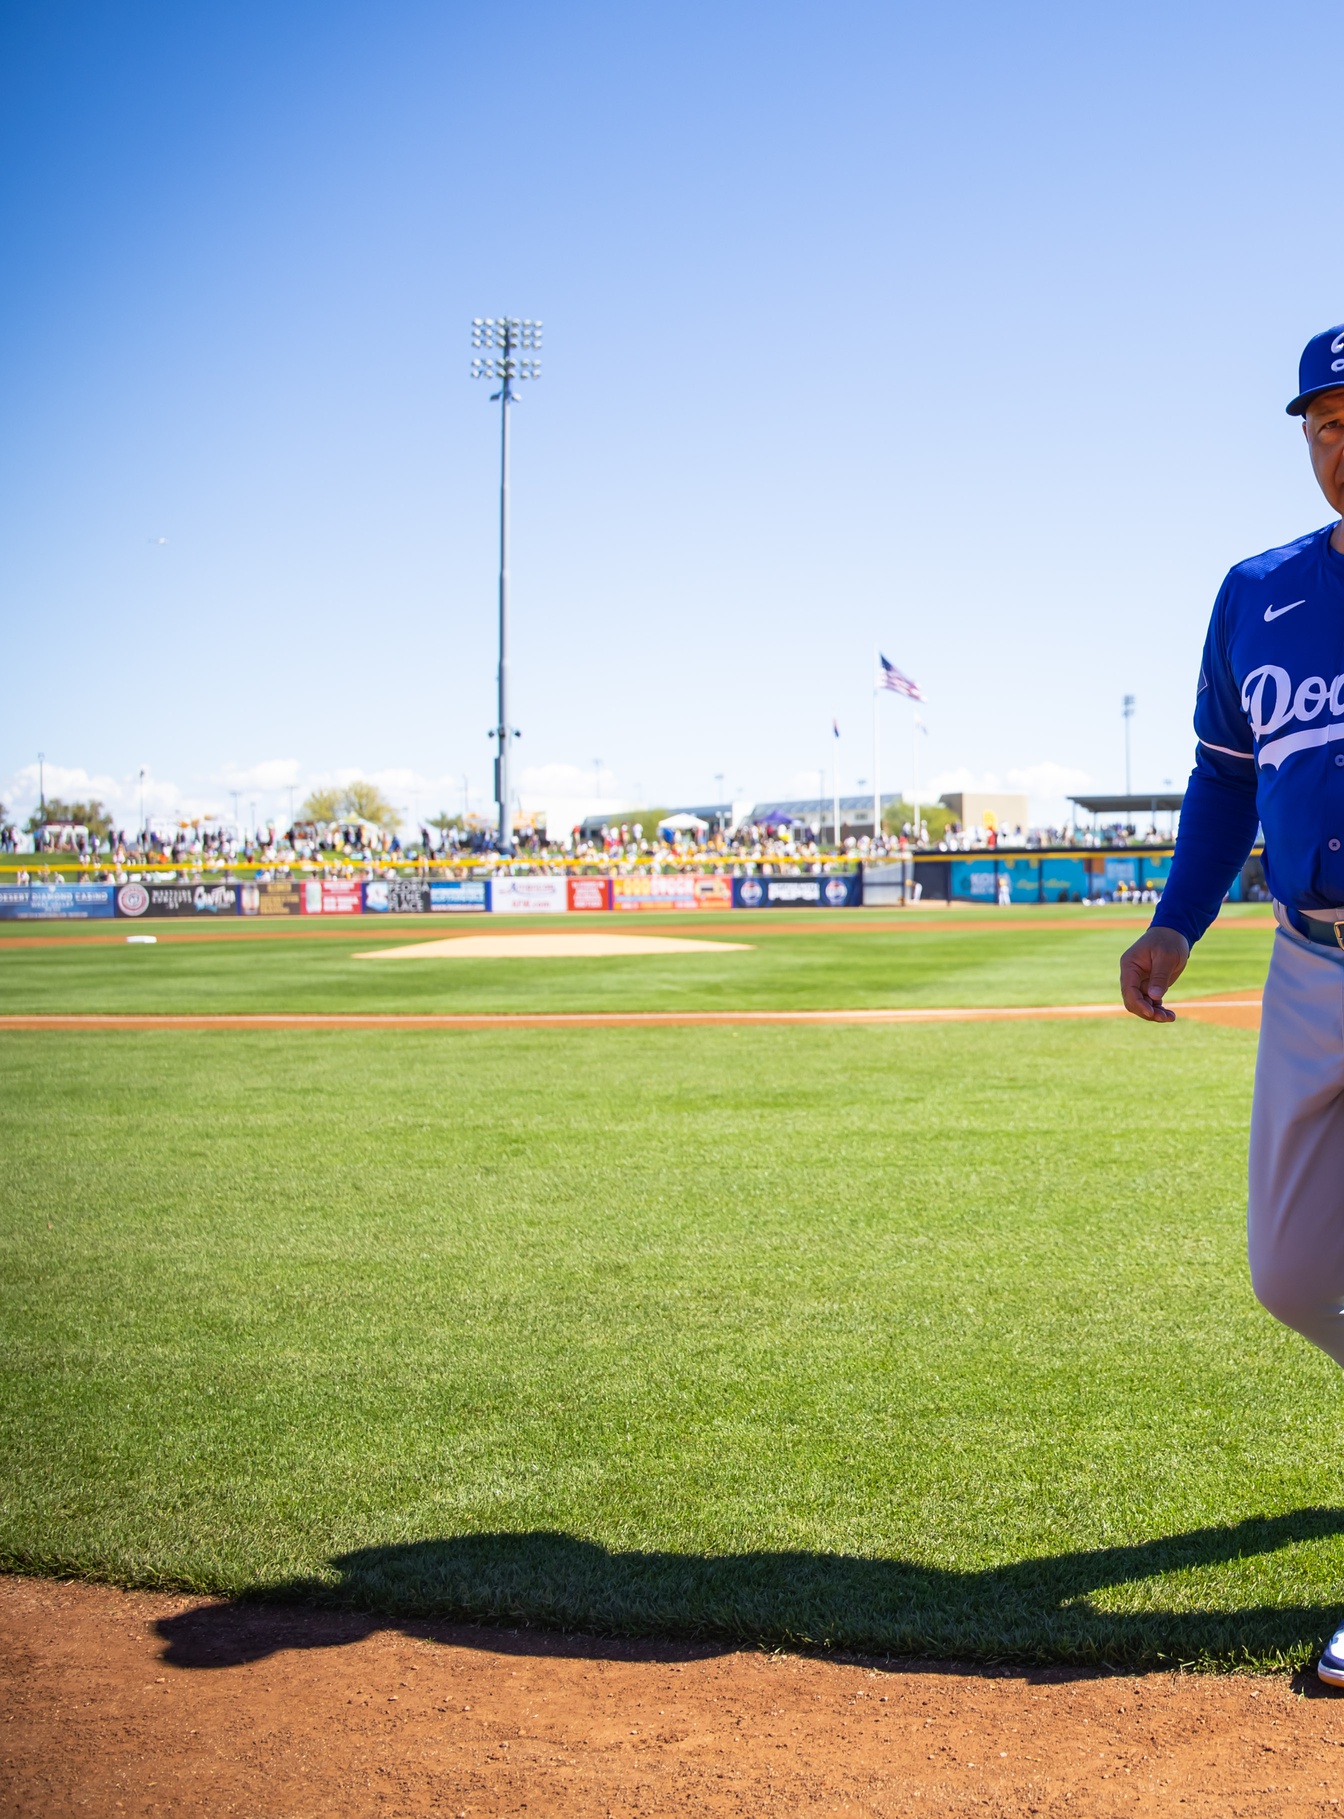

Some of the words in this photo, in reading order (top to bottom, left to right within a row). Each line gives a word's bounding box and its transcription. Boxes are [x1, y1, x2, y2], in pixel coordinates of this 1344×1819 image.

[388, 882, 430, 893] PEORIA
[31, 892, 73, 902] DIAMOND
[75, 891, 108, 901] CASINO
[402, 893, 421, 901] THE
[388, 901, 424, 912] PLACE
